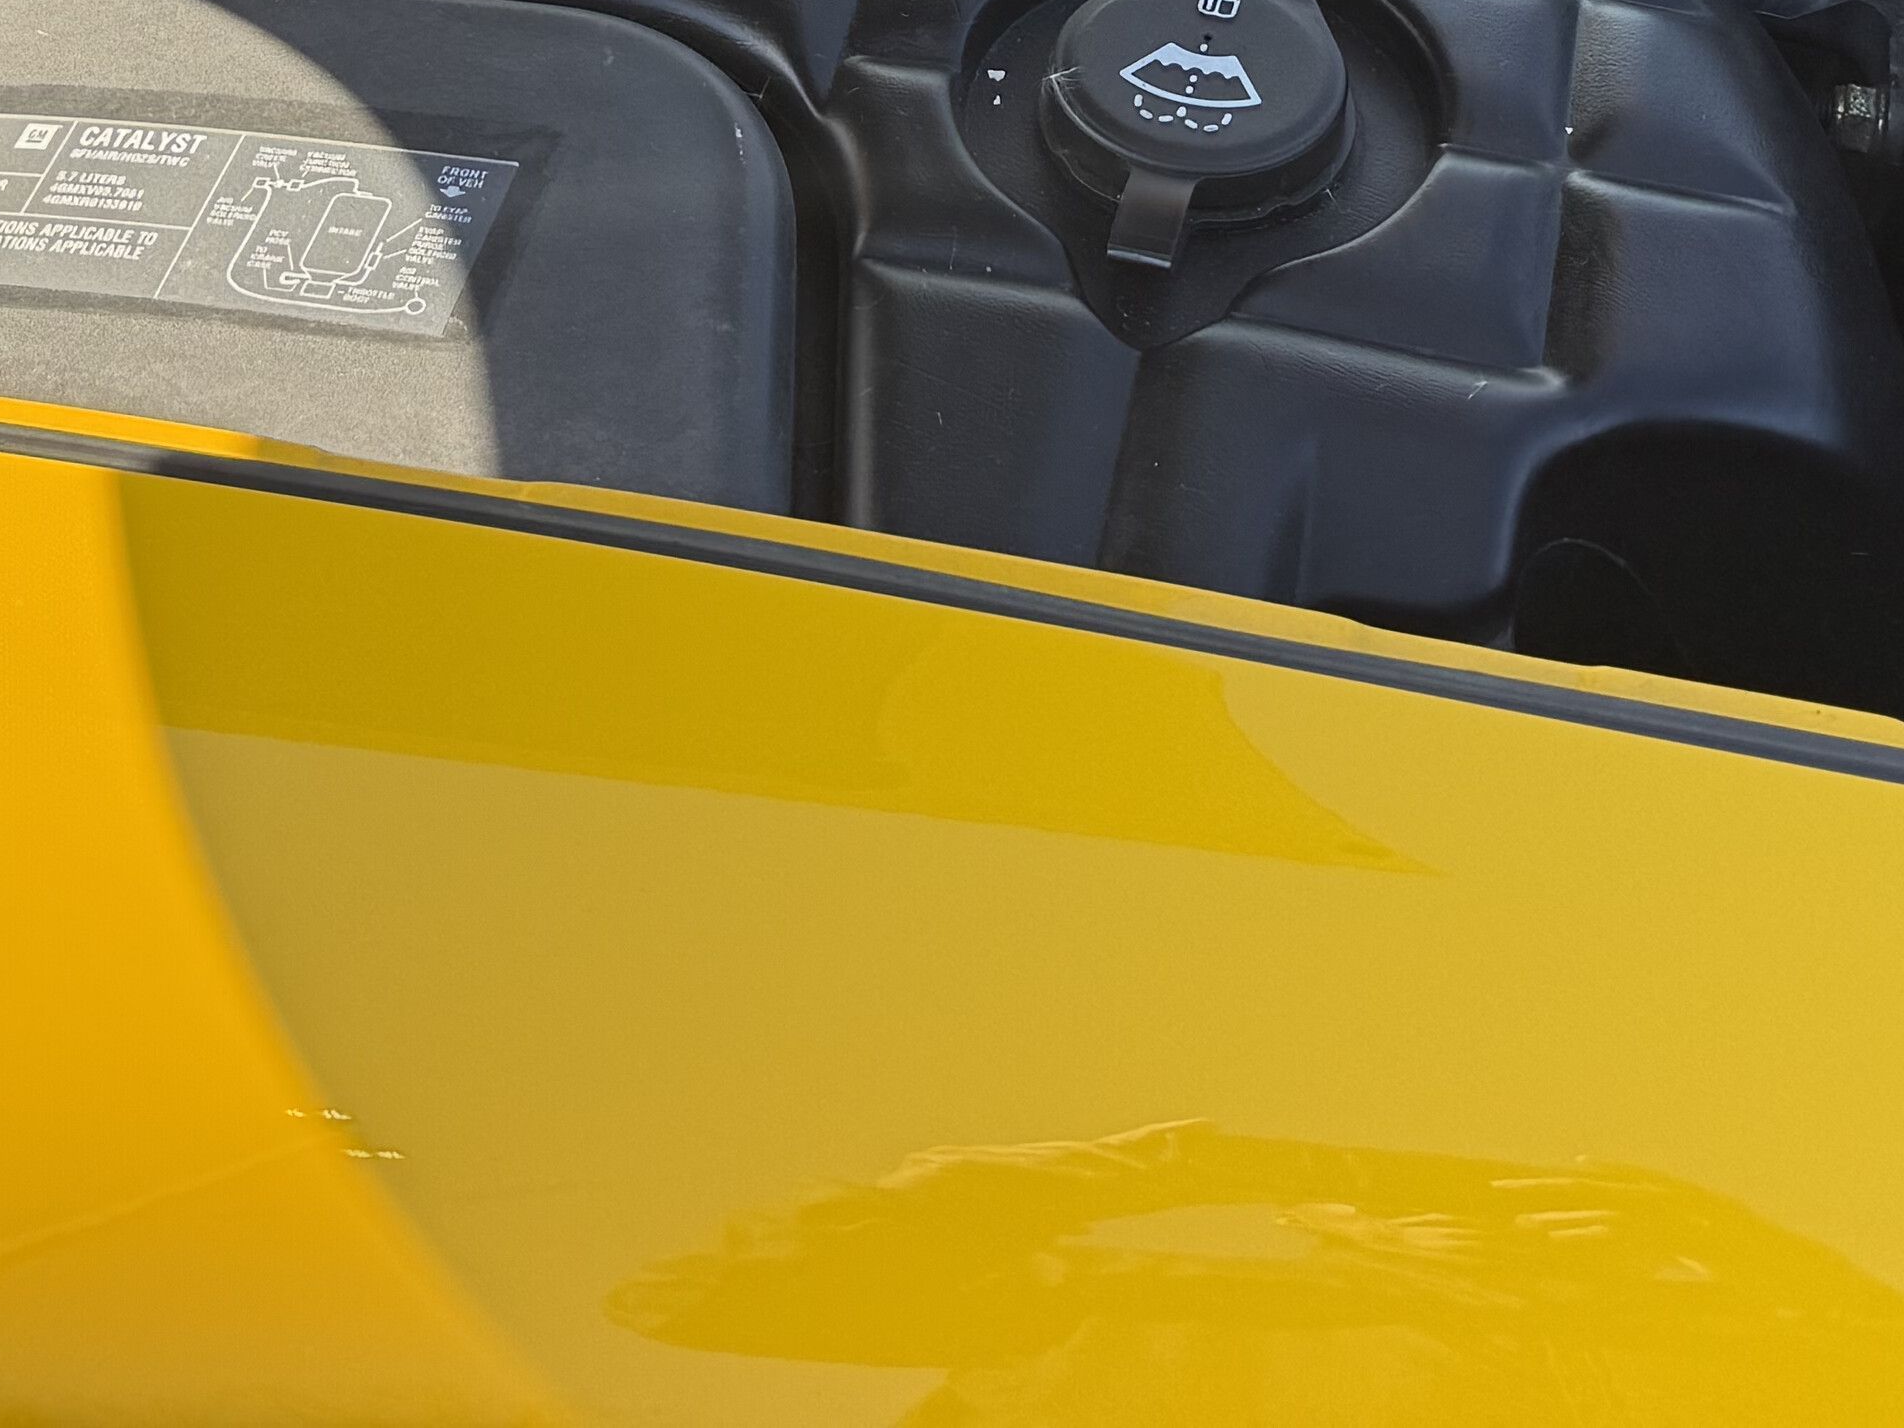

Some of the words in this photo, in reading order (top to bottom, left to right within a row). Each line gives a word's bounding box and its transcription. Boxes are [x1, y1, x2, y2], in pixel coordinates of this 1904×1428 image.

[79, 126, 207, 154] CATALYST
[79, 172, 126, 185] LITERS
[442, 165, 488, 179] FRONT
[437, 175, 455, 185] OF
[459, 176, 485, 188] VEH
[39, 224, 135, 243] APPLICABLE
[138, 231, 159, 245] TO
[49, 240, 144, 260] APPLICABLE
